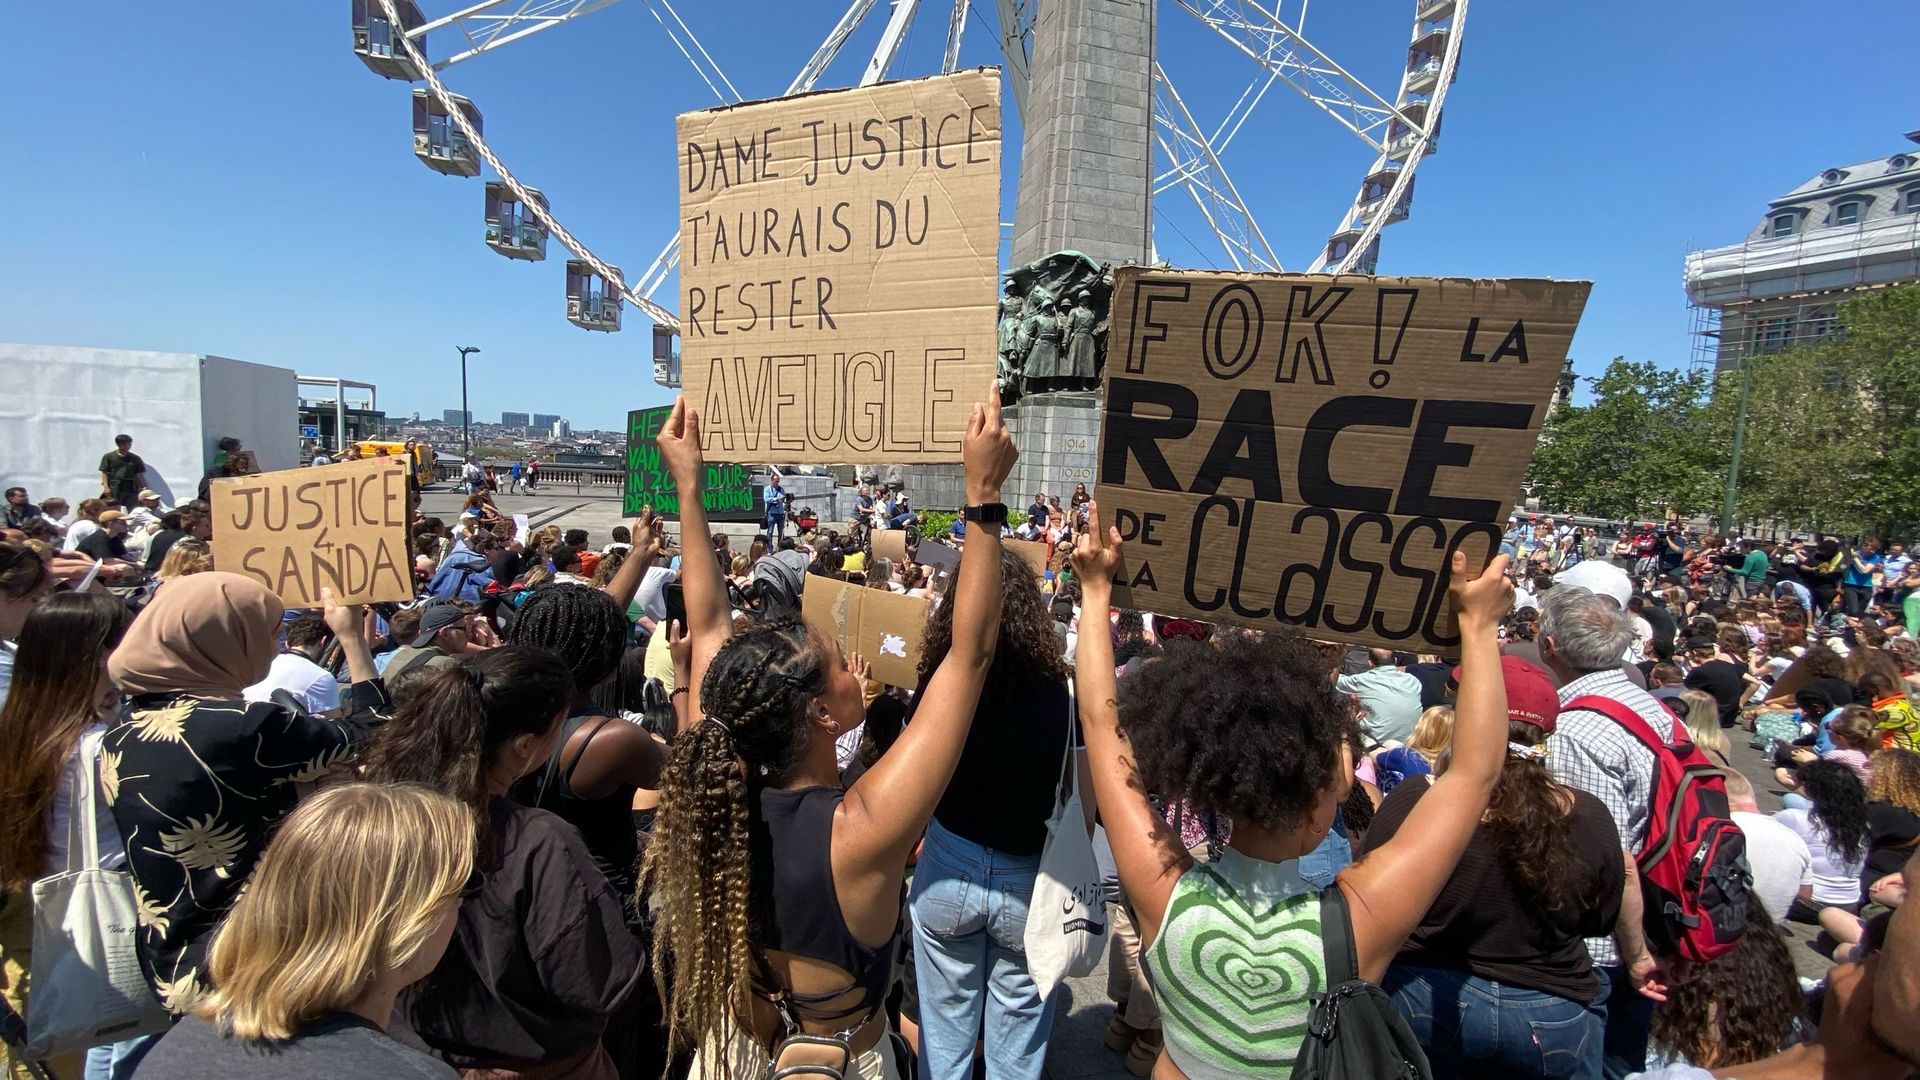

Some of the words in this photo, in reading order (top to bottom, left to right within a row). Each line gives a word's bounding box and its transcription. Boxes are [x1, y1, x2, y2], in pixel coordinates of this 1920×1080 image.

[687, 127, 781, 193] DAME
[803, 104, 990, 186] JUSTICE
[687, 202, 852, 266] T'AURAIS
[875, 195, 929, 250] DU
[689, 276, 837, 338] RESTER
[1459, 317, 1529, 364] LA
[701, 348, 965, 453] AVEUGLE
[628, 444, 660, 471] VAN
[1064, 438, 1087, 453] 1914
[1101, 377, 1535, 522] RACE
[628, 471, 644, 493] IN
[1061, 467, 1091, 481] 1940
[231, 470, 403, 531] JUSTICE
[314, 526, 335, 554] 4
[1115, 508, 1166, 546] DE
[242, 537, 405, 603] SANDA
[107, 924, 126, 935] The
